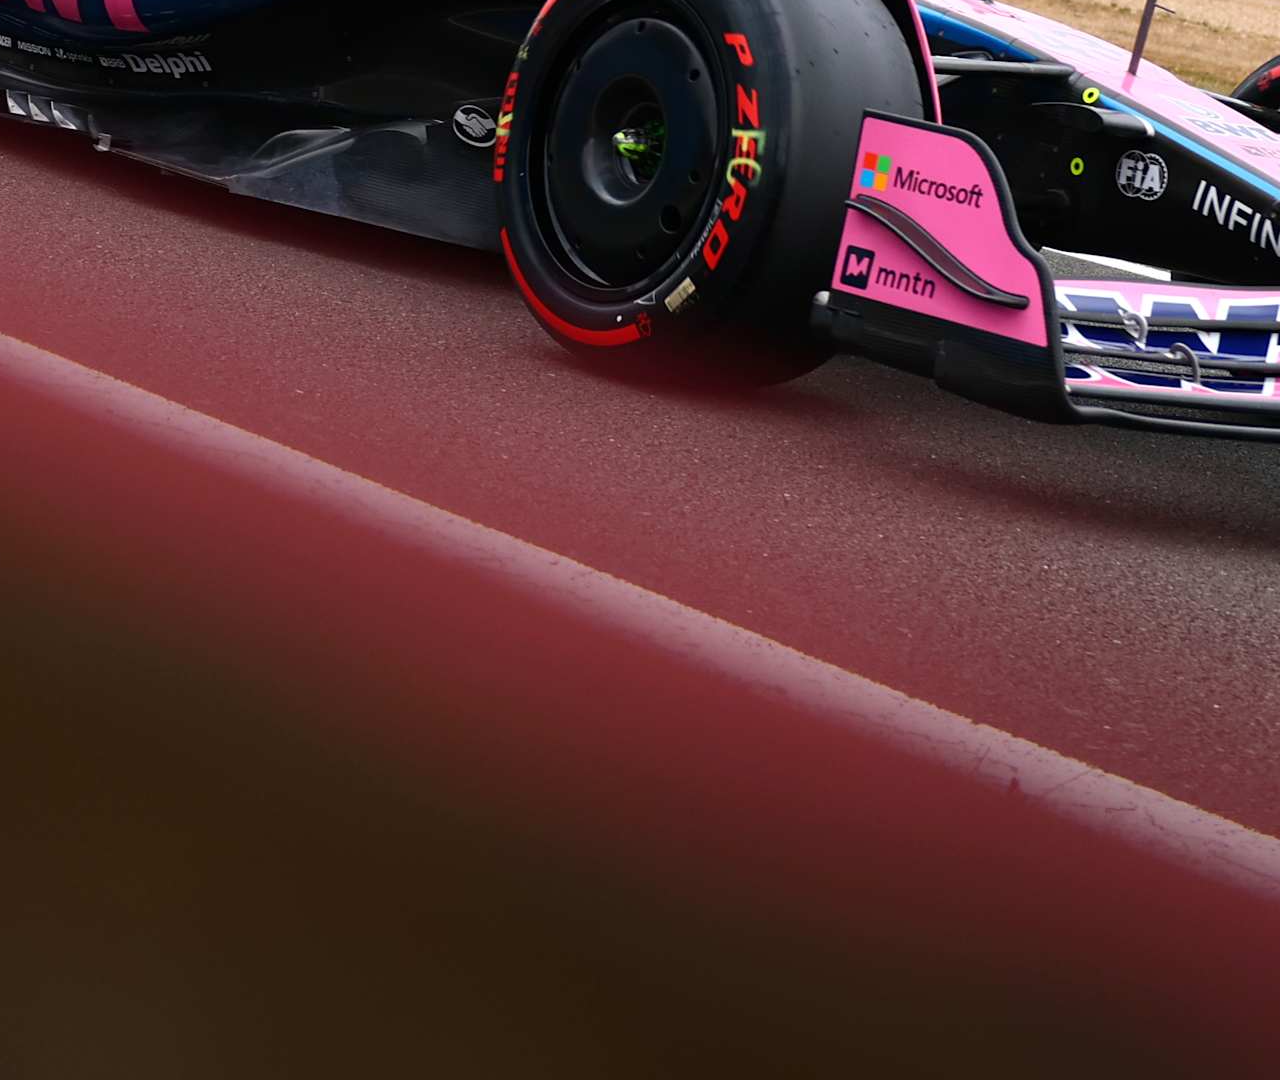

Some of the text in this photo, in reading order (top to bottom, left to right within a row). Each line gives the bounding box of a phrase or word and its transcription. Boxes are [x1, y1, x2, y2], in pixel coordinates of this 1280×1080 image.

[123, 51, 212, 78] Delphi
[893, 166, 983, 209] Microsoft
[875, 266, 936, 299] mntn
